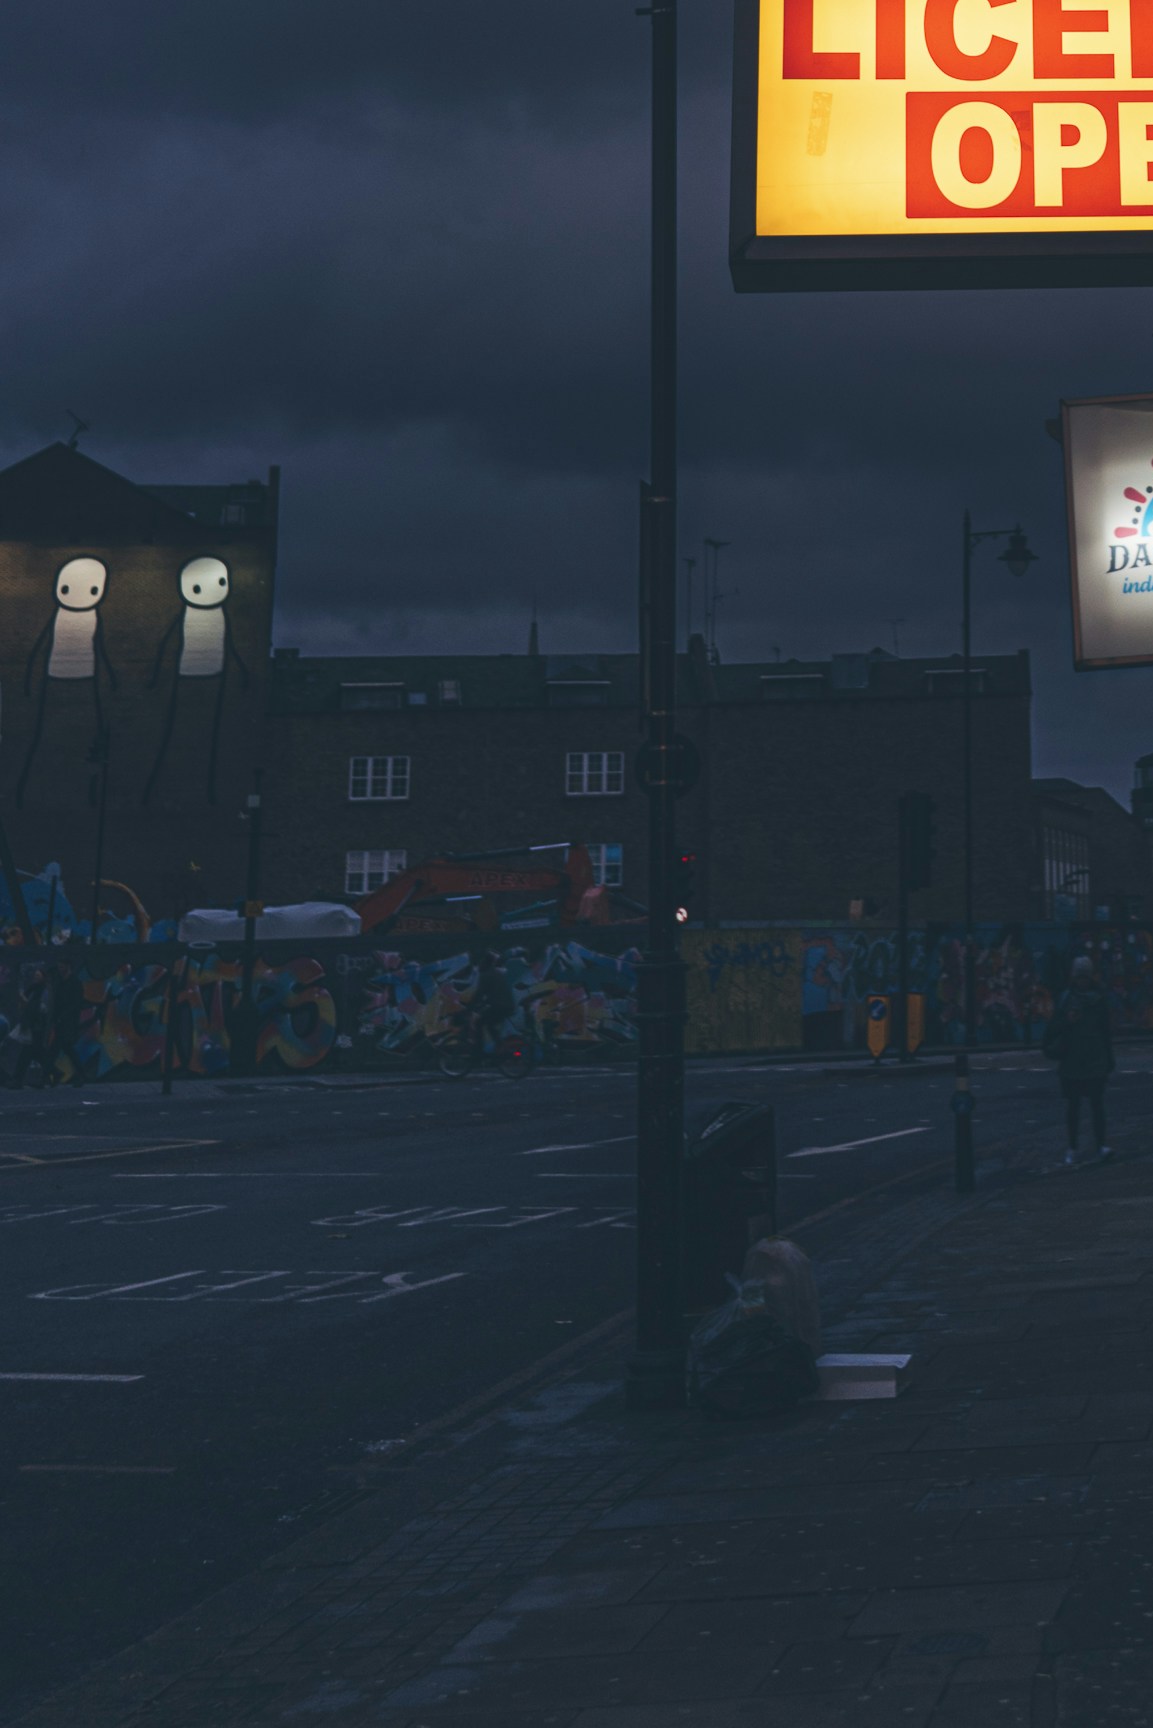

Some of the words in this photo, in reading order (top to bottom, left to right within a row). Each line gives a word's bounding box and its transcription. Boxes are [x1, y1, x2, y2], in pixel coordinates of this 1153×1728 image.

[469, 871, 530, 889] APEX
[308, 1204, 637, 1228] LEAR
[26, 1270, 470, 1304] KEEP
